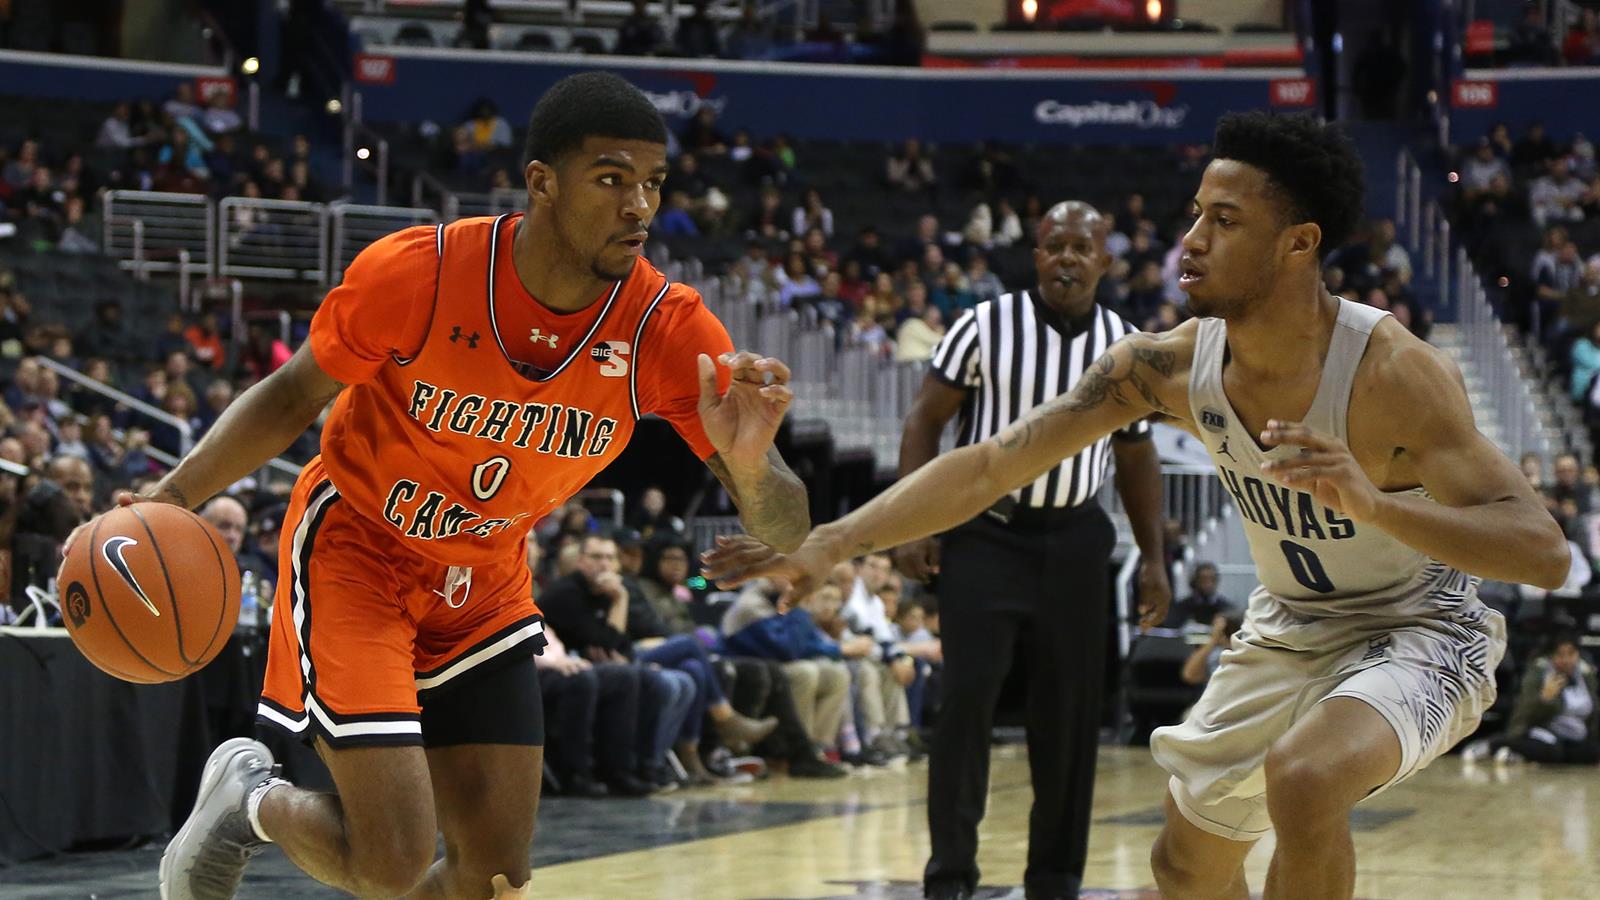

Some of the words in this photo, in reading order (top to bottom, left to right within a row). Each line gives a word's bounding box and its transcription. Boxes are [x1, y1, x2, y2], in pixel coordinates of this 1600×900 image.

[591, 348, 612, 357] BIG
[408, 380, 618, 459] FIGHTING
[470, 454, 512, 500] 0
[1219, 464, 1356, 540] HOYAS
[382, 479, 531, 540] CAME
[1280, 539, 1336, 594] 0
